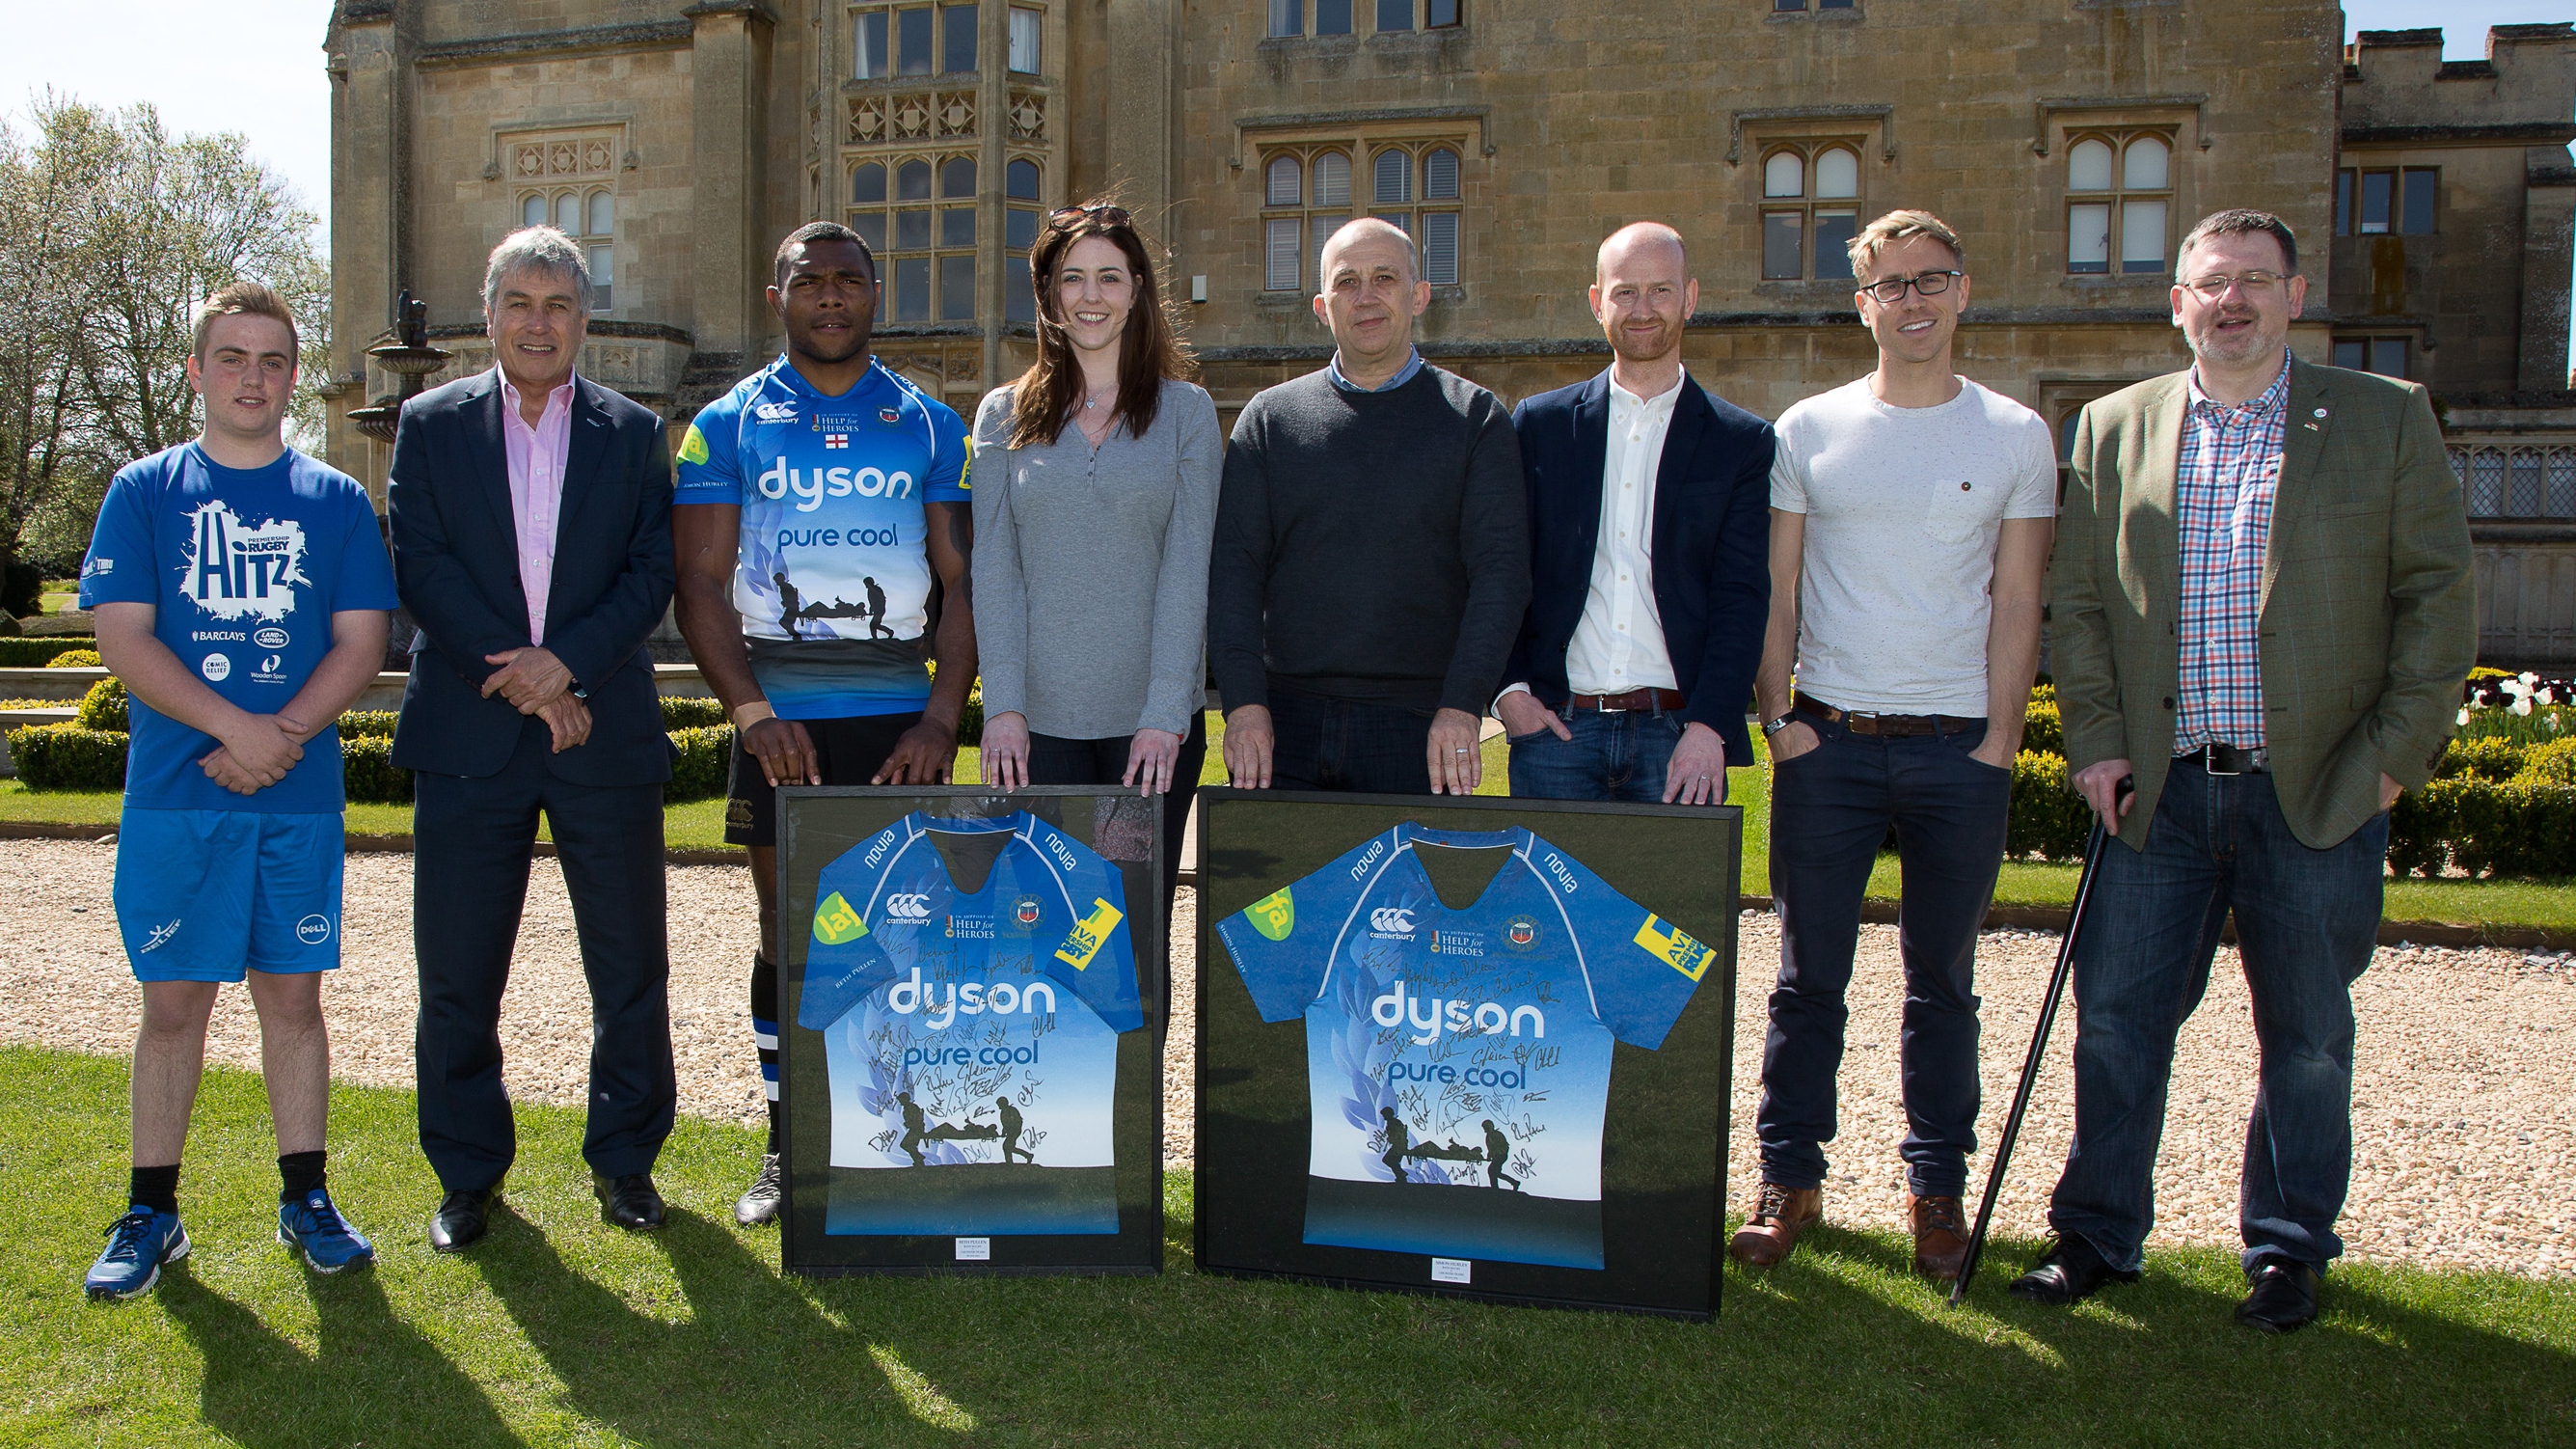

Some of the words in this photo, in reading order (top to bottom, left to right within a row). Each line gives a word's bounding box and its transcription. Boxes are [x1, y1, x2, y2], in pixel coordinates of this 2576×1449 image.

[756, 417, 800, 425] canterbury
[846, 417, 858, 426] for
[758, 455, 913, 512] dyson
[248, 541, 290, 553] RUGBY
[777, 529, 840, 554] pure
[847, 523, 899, 546] cool
[200, 631, 246, 642] BARCLAYS
[864, 830, 896, 869] novia
[1044, 833, 1077, 872] novia
[1350, 840, 1384, 882] novia
[1543, 852, 1578, 894] novia
[300, 923, 327, 935] DELL
[886, 917, 932, 927] canterbury
[956, 919, 981, 929] HELP
[982, 920, 994, 930] for
[957, 929, 995, 939] HEROES
[1220, 924, 1234, 946] SIMON
[1231, 944, 1247, 972] HURLEY
[1369, 932, 1416, 942] canterbury
[1442, 935, 1470, 945] HELP
[1470, 938, 1484, 947] for
[1443, 944, 1484, 957] HEROES
[835, 973, 853, 989] BETH
[852, 958, 877, 975] PULLEN
[888, 967, 1056, 1029] dyson
[1371, 980, 1544, 1046] dyson
[904, 1047, 971, 1072] pure
[979, 1040, 1039, 1065] cool
[1388, 1062, 1456, 1086] pure
[1464, 1063, 1526, 1089] cool
